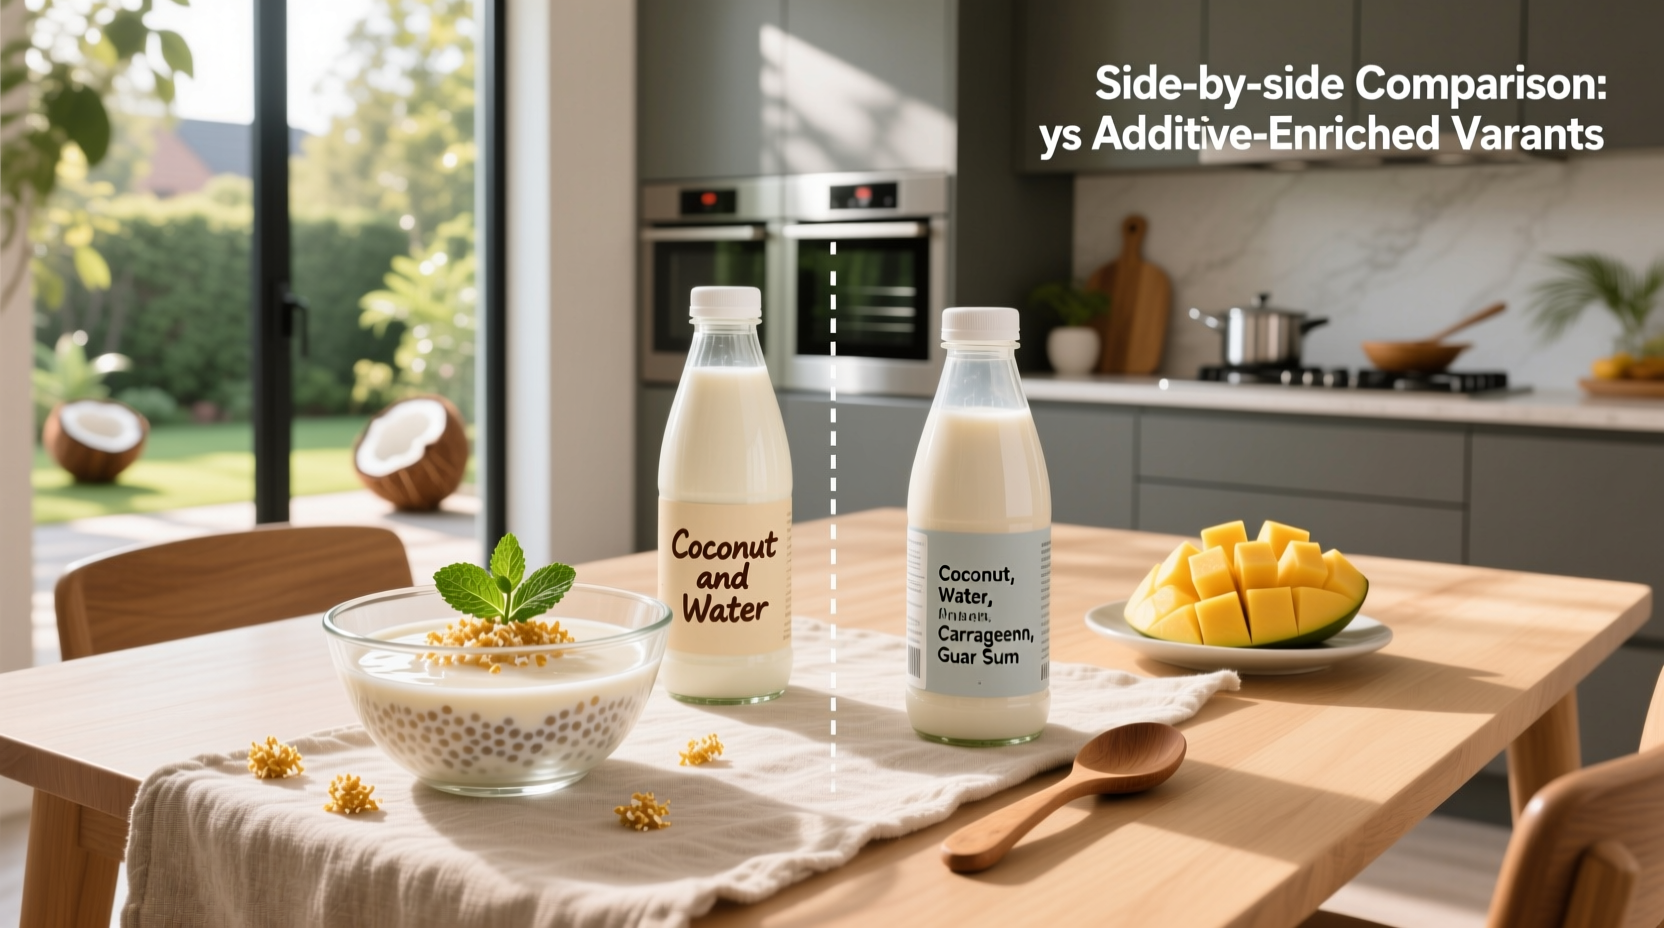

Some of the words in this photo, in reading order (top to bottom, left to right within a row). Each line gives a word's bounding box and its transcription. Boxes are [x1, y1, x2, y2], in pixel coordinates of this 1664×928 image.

[671, 527, 779, 560] Coconut
[696, 561, 750, 590] and
[938, 564, 1015, 585] Coconut,
[682, 593, 769, 623] Water
[938, 586, 993, 607] Water,
[937, 646, 977, 665] Guar
[982, 648, 1019, 665] Sum
